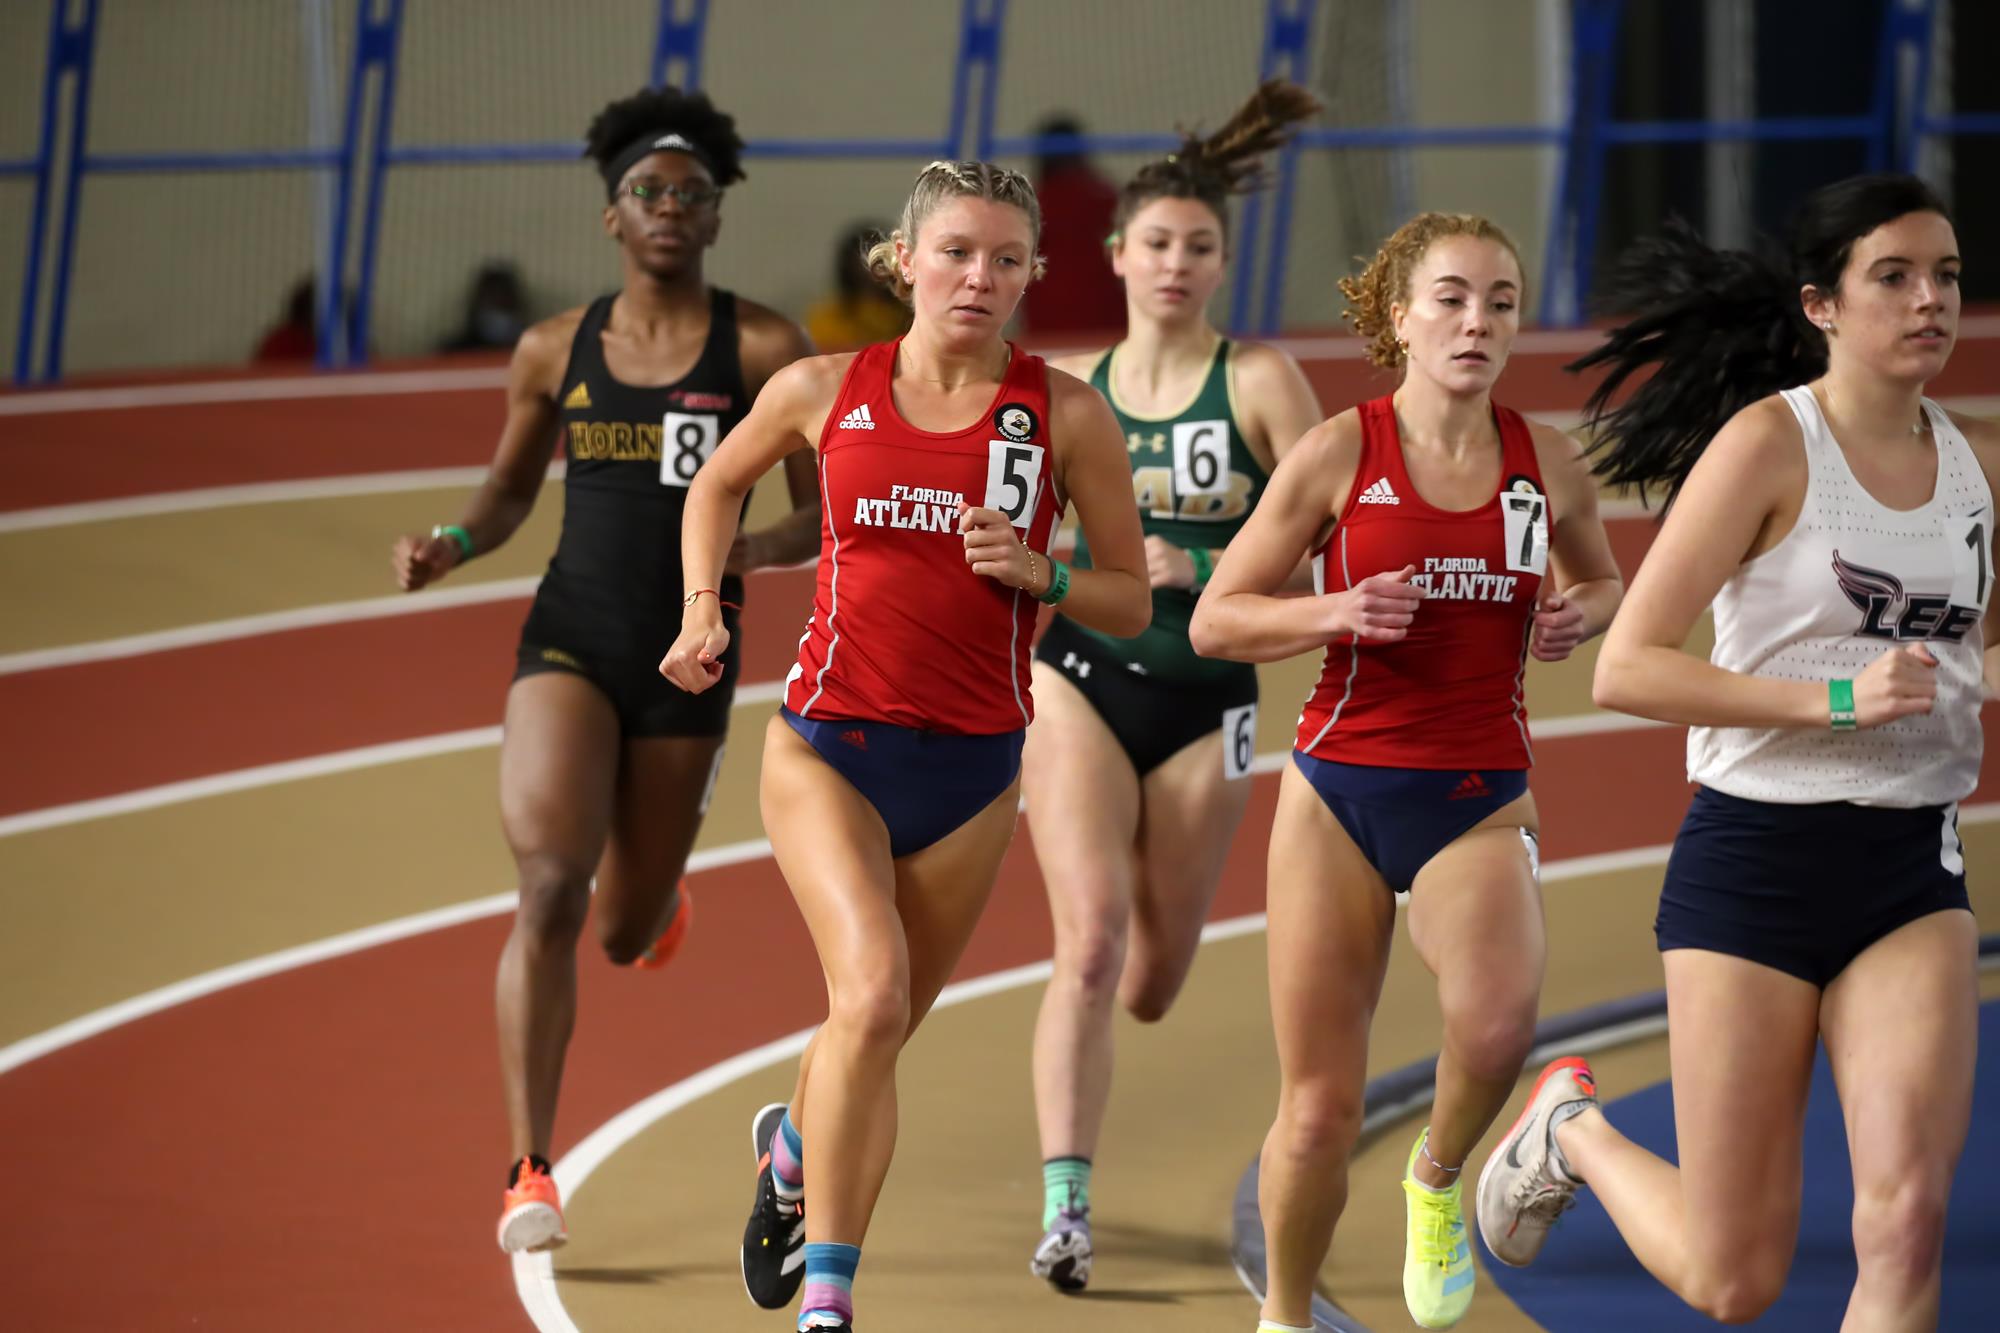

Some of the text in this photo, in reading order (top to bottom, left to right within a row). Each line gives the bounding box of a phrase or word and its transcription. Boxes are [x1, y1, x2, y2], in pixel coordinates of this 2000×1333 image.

[673, 422, 706, 480] 8
[839, 418, 875, 430] adidas
[998, 447, 1033, 521] 5
[1188, 428, 1218, 488] 6
[890, 484, 964, 507] FLORIDA
[1359, 493, 1400, 505] adidas
[1509, 498, 1542, 567] 7
[1424, 558, 1487, 573] FLORIDA
[1965, 522, 1987, 605] 1
[1854, 592, 1983, 645] LEE
[1233, 711, 1251, 772] 6
